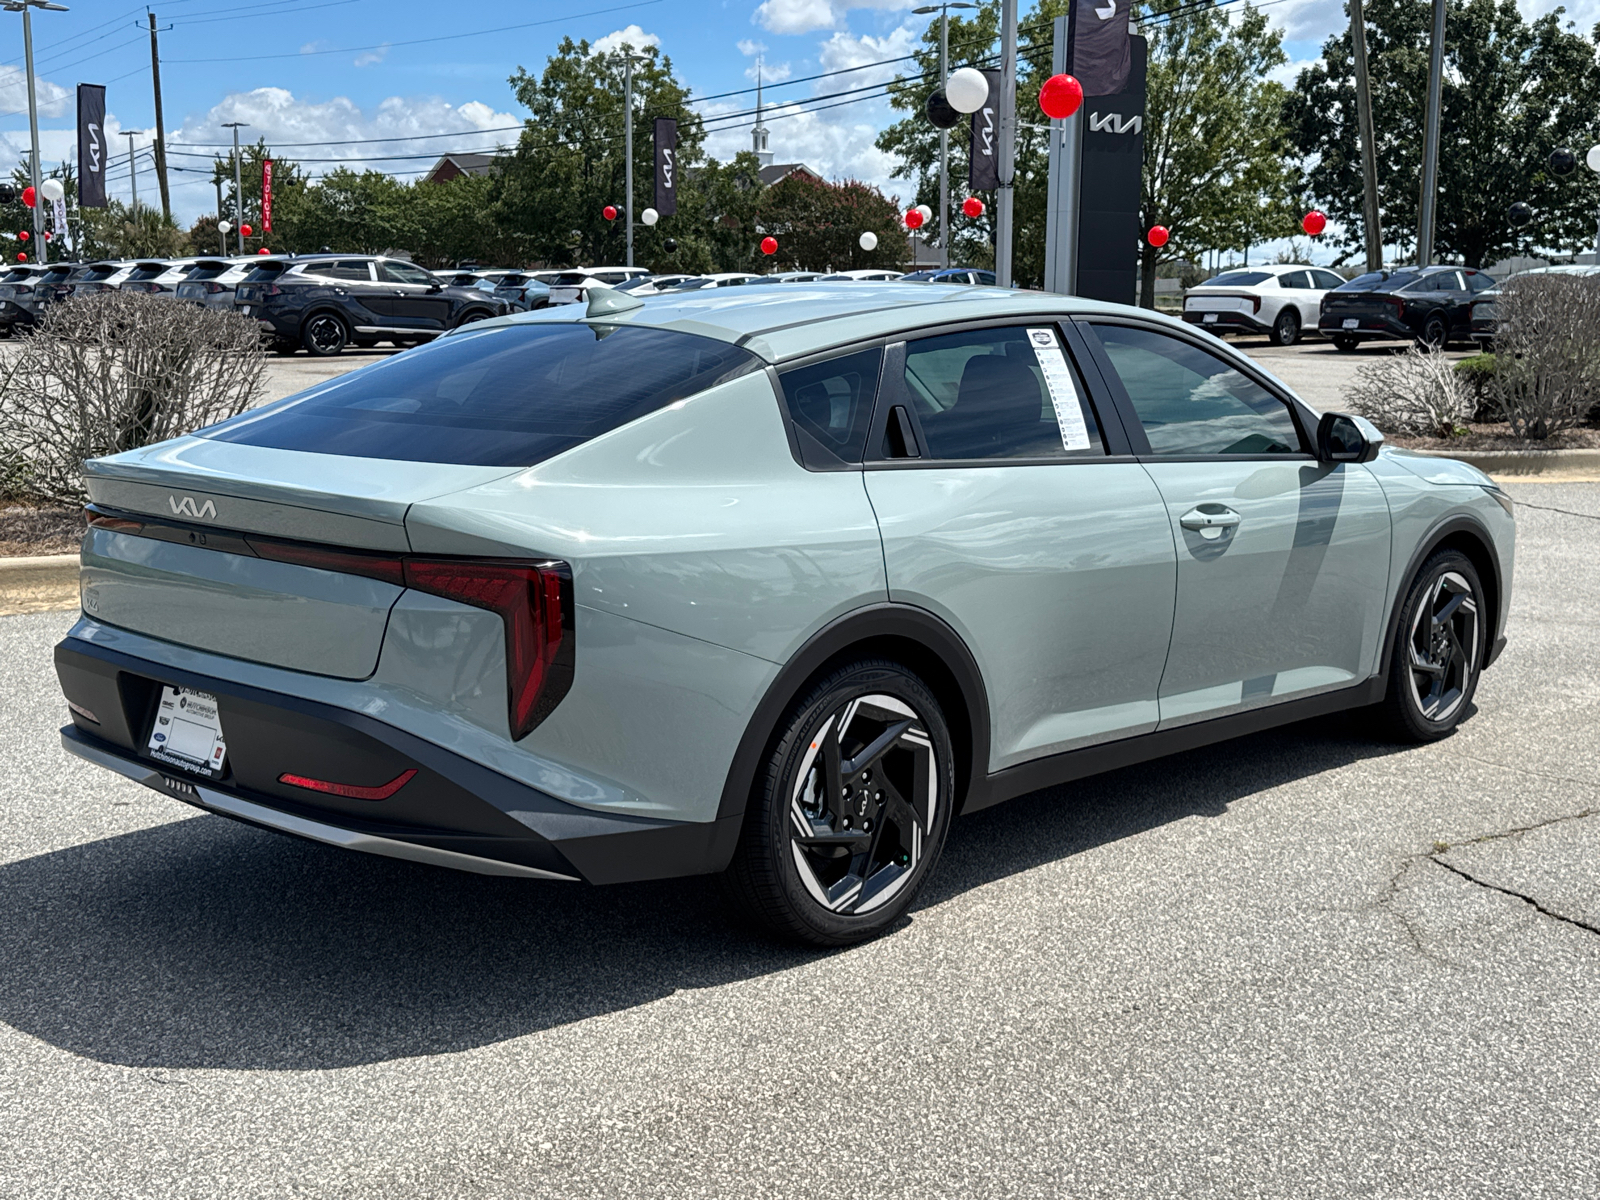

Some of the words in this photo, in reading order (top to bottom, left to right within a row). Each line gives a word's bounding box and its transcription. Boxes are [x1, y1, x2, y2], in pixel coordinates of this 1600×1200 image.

[981, 107, 994, 156] KIA
[1089, 111, 1143, 135] KIA
[87, 123, 100, 173] KIA
[663, 148, 673, 188] KIA
[264, 175, 272, 229] TOYOTA
[168, 495, 218, 520] KIA
